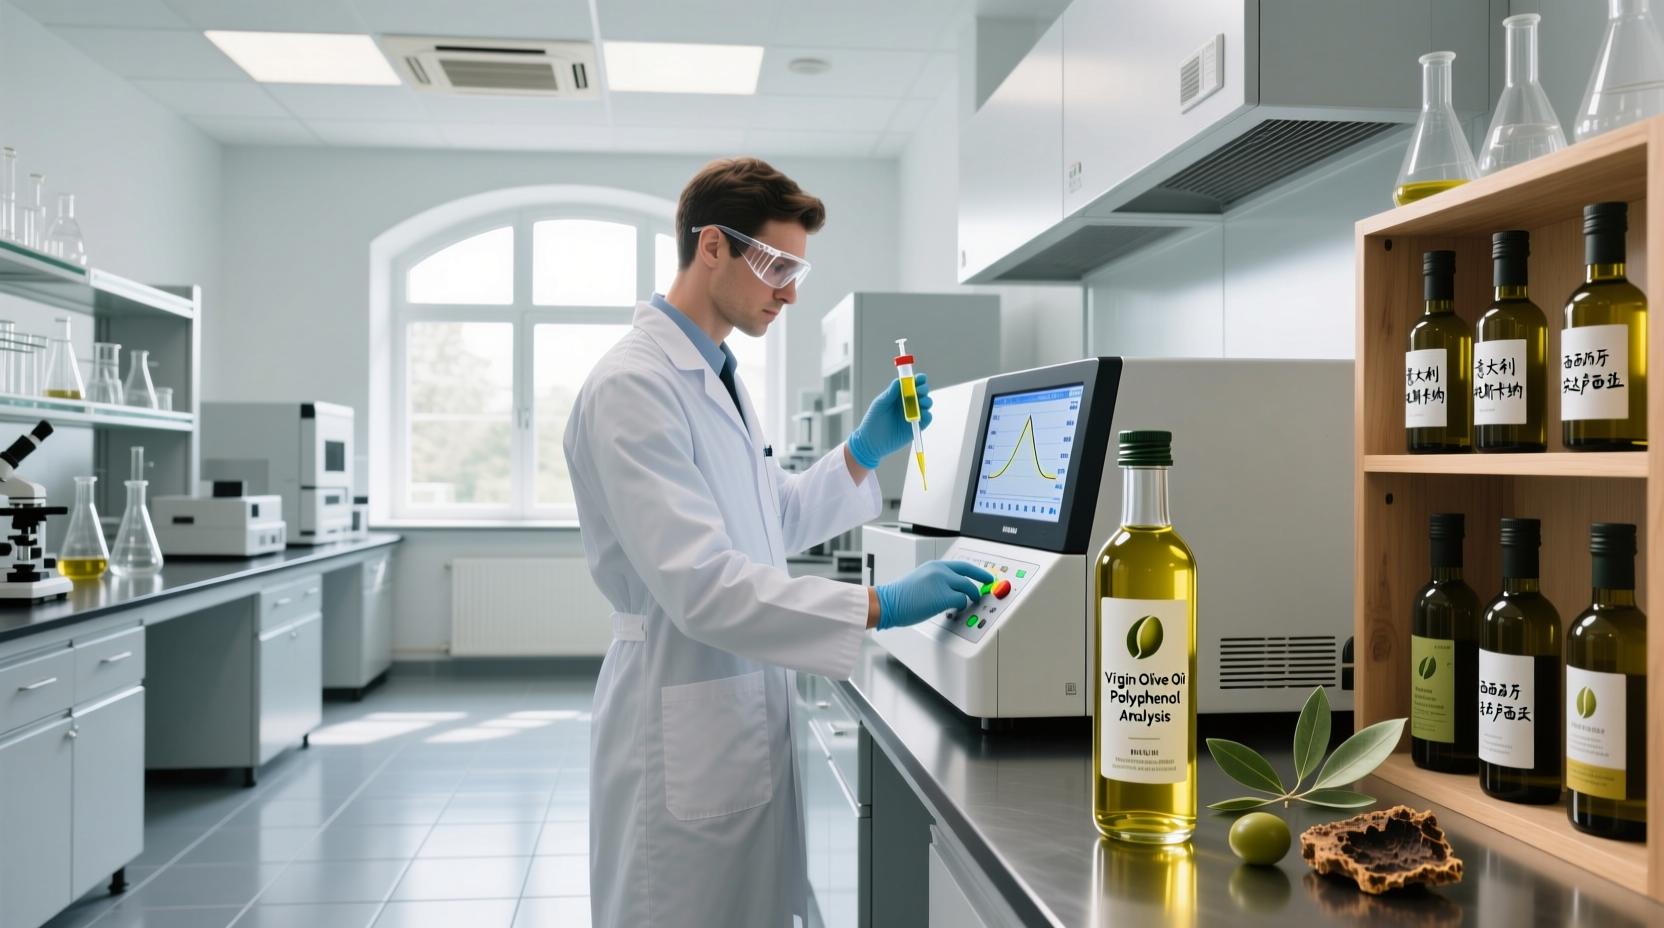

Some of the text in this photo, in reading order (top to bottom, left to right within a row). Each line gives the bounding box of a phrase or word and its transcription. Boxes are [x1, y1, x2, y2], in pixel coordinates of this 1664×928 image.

[1139, 673, 1169, 686] Olive
[1110, 689, 1180, 707] Polyphenol
[1119, 709, 1171, 727] Analysis
